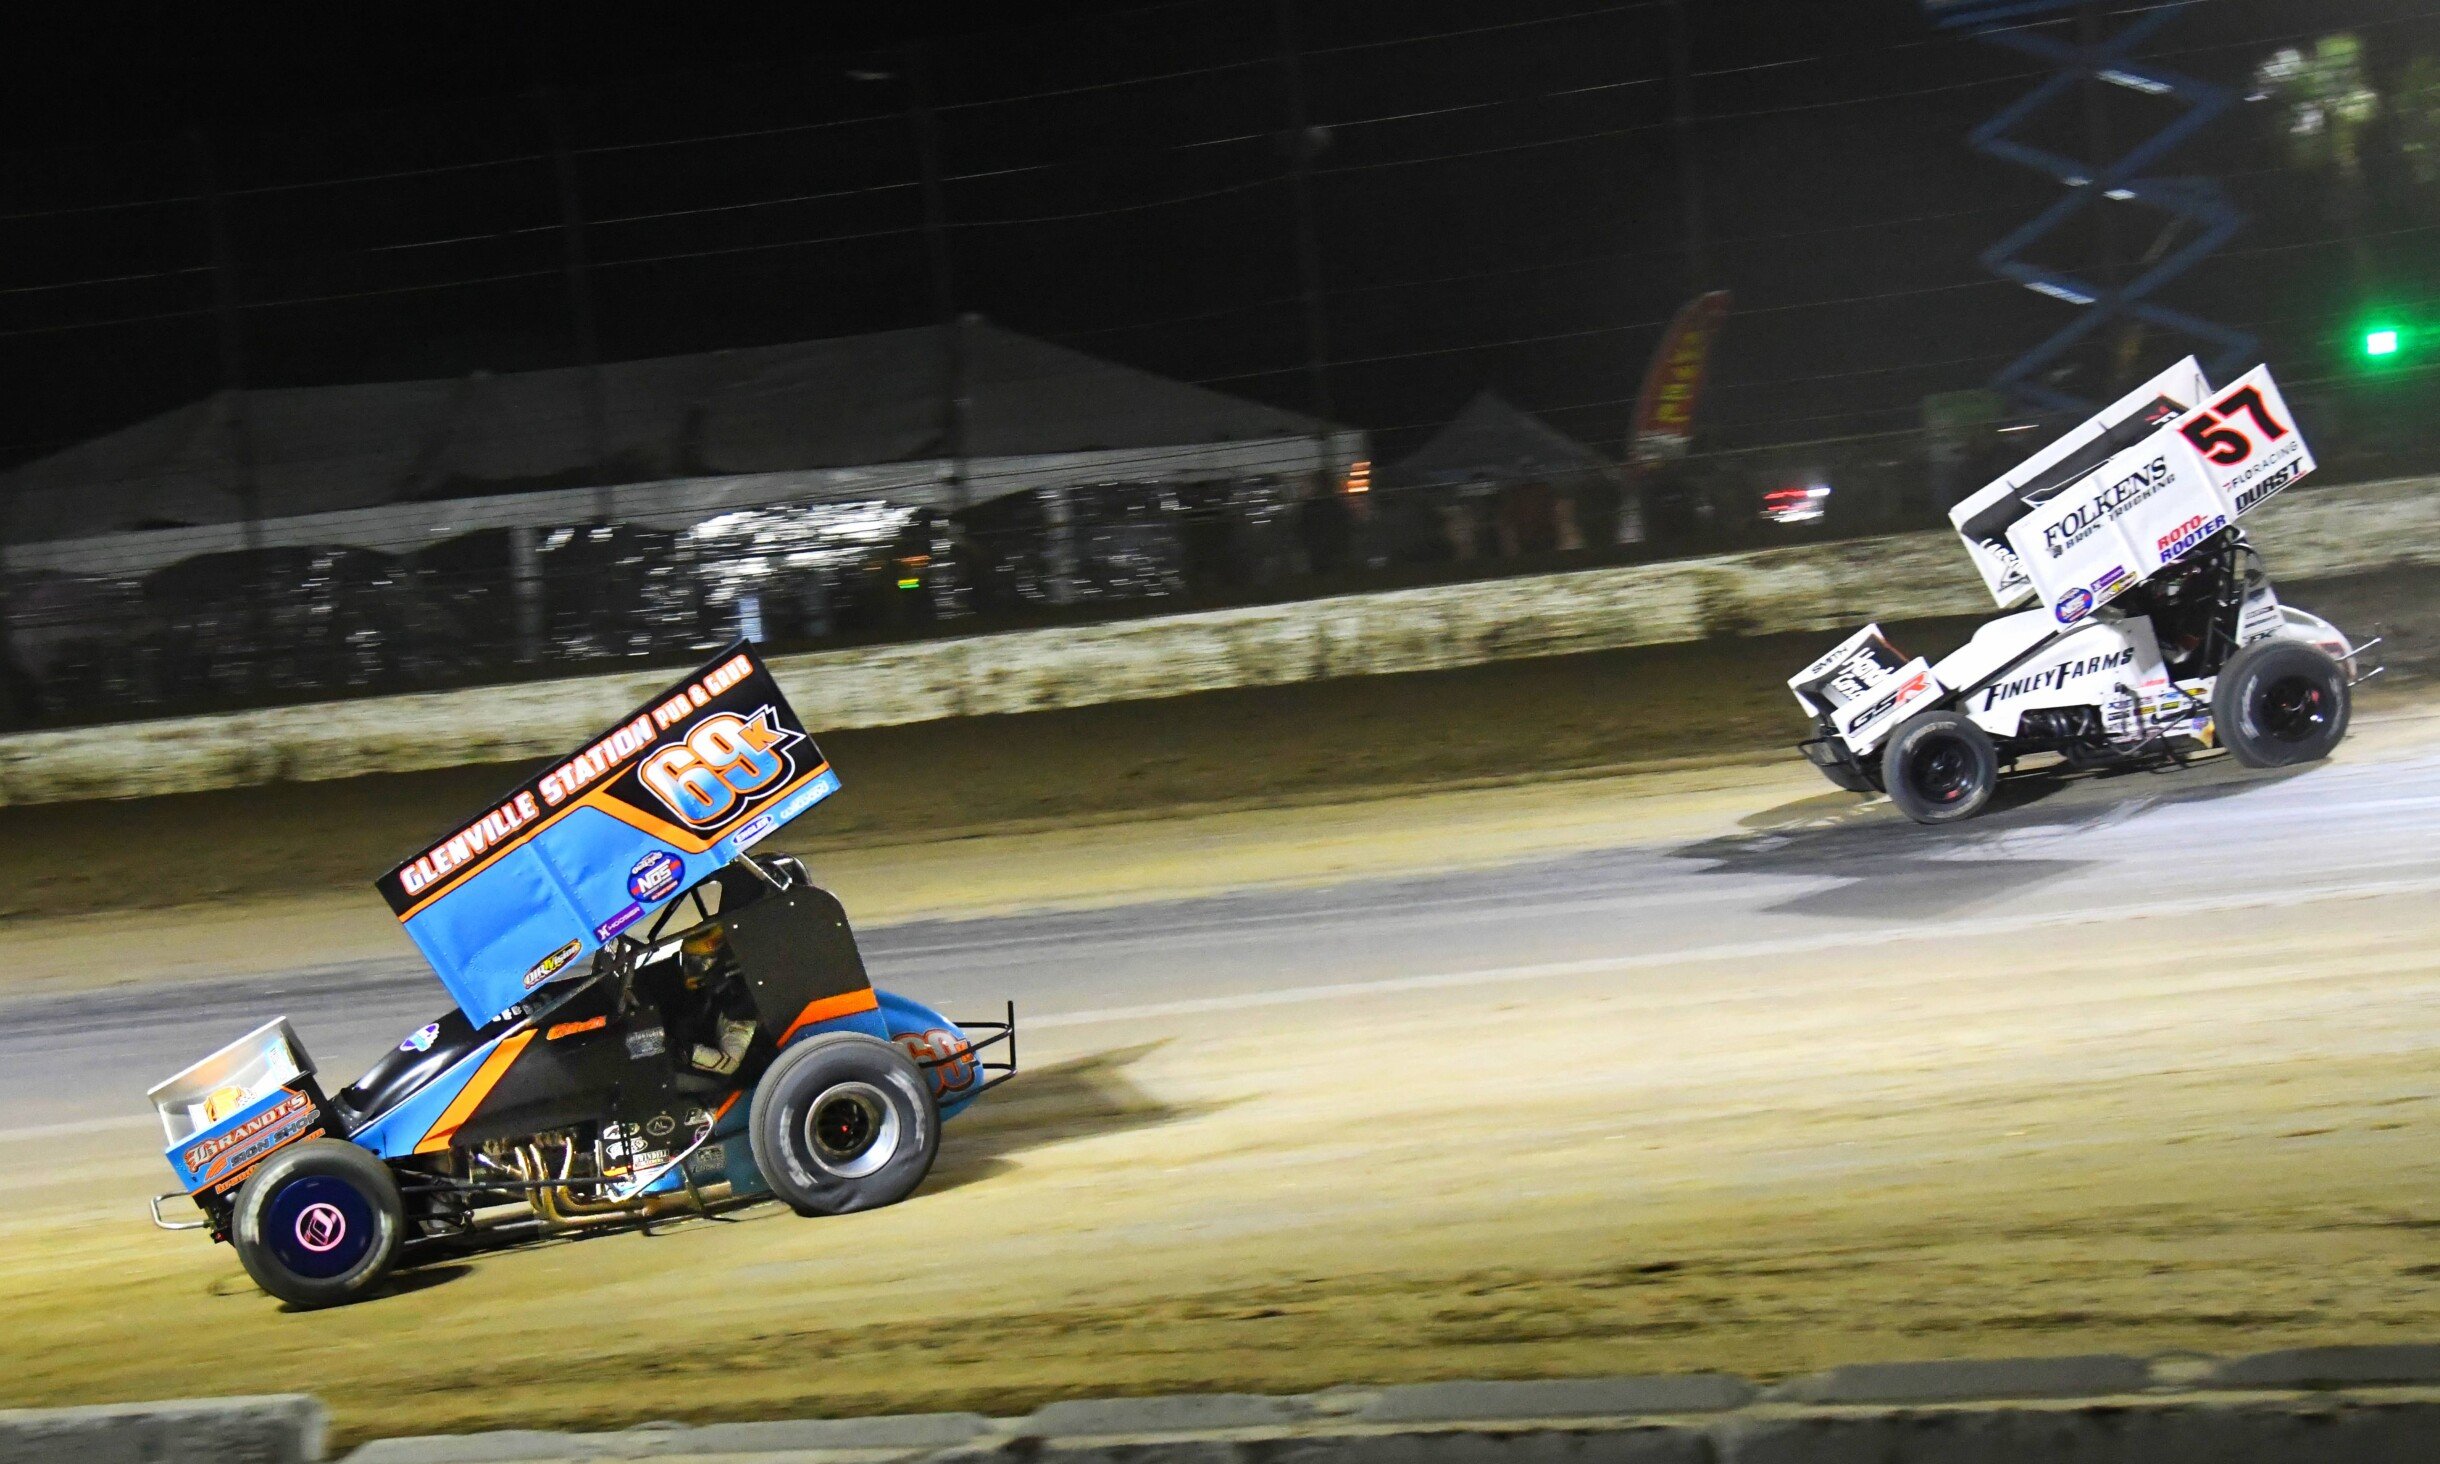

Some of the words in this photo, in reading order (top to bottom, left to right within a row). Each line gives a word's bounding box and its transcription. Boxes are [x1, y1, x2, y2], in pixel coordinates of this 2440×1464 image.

[2177, 384, 2289, 466] 57
[2043, 455, 2167, 548] FOLKENS
[2109, 474, 2175, 521] TRUCKING
[2235, 457, 2302, 511] DURST
[2157, 515, 2208, 550] ROTO-
[2160, 514, 2226, 563] ROOTER
[1848, 670, 1931, 736] GSR
[1984, 669, 2056, 712] FINLEY
[2055, 647, 2135, 690] FARMS
[400, 790, 540, 896] GLENVILLE
[540, 714, 657, 807] STATION
[653, 694, 692, 730] PUB
[688, 684, 712, 706] &
[706, 654, 753, 696] GRUB
[636, 858, 672, 894] NOS
[184, 1089, 311, 1172] BRANDT'S
[230, 1138, 270, 1168] SIGN
[273, 1109, 320, 1141] SHOP
